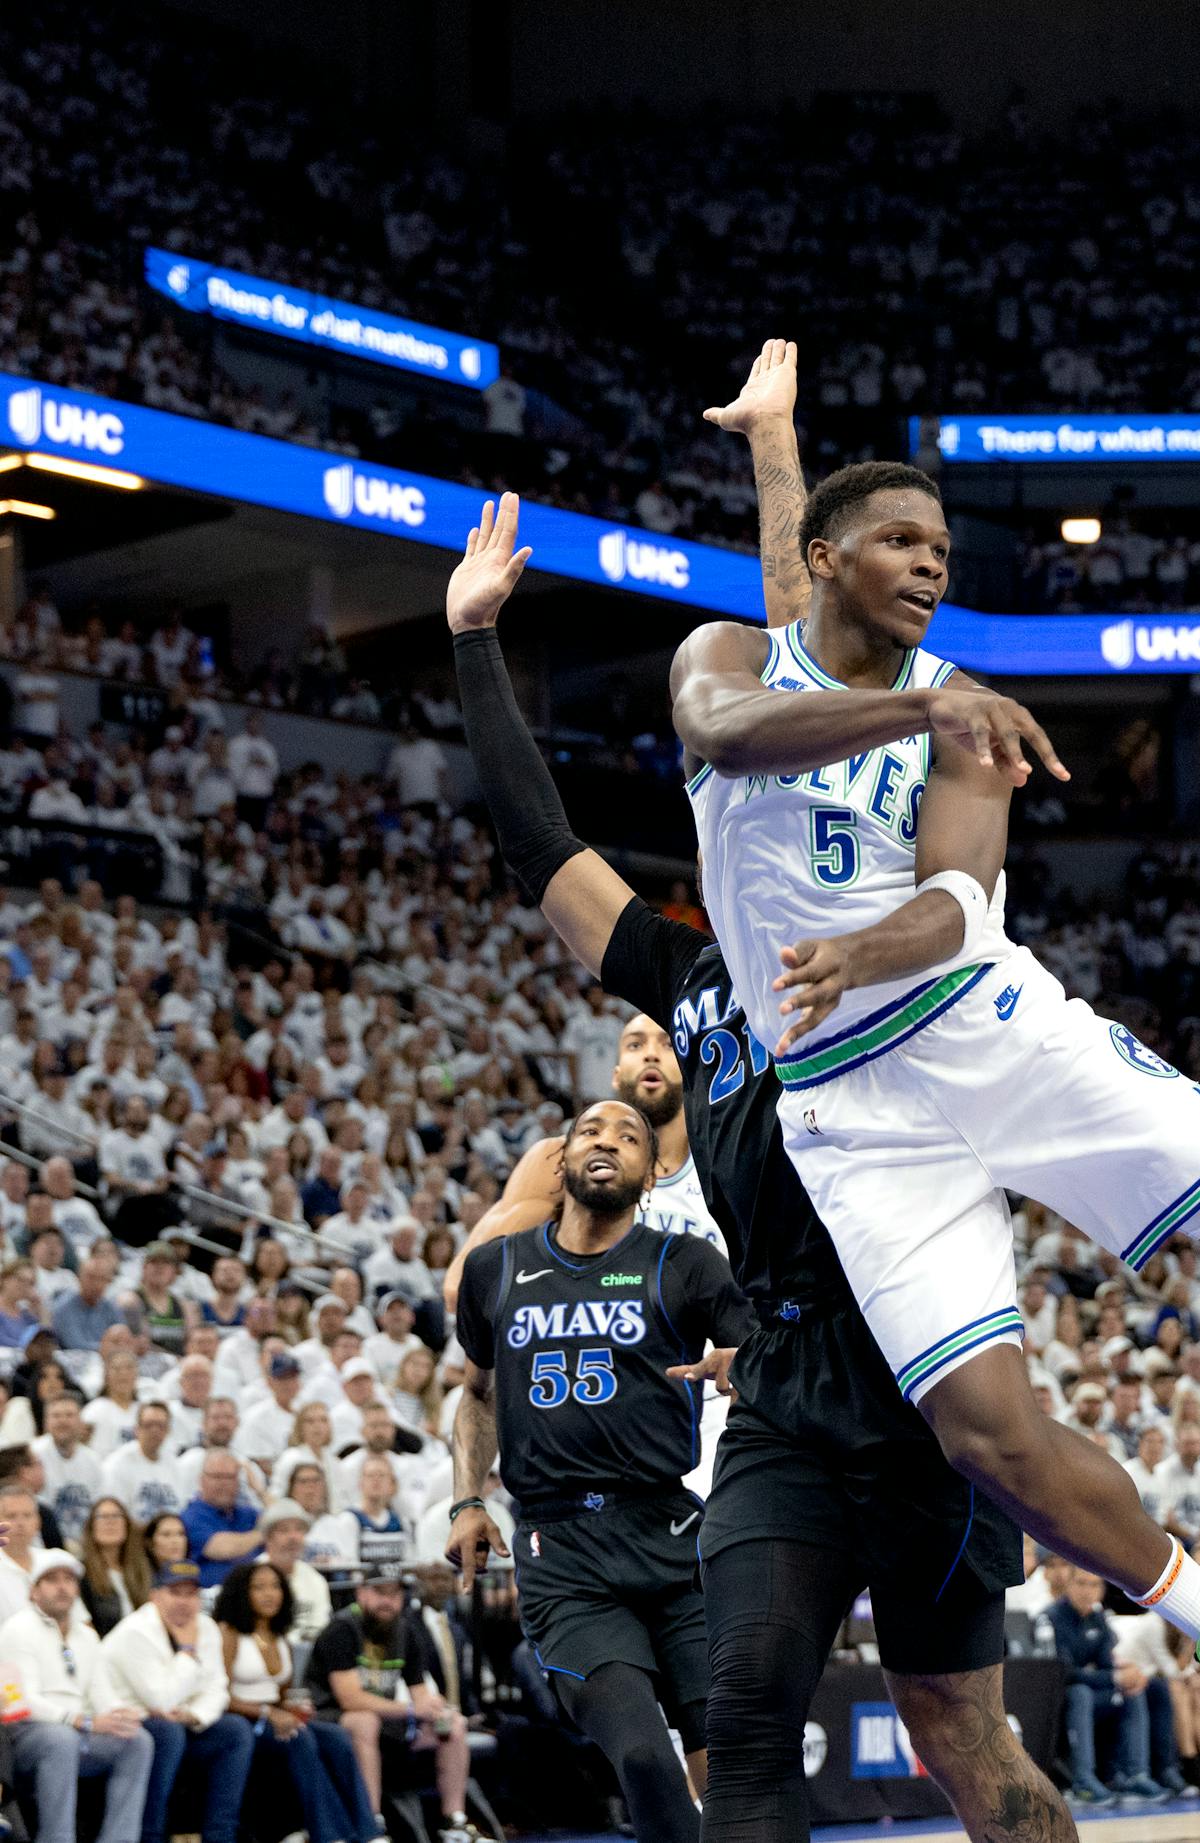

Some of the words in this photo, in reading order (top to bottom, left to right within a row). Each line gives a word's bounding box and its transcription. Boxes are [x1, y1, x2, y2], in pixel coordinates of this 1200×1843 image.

[361, 325, 449, 370] matters
[42, 399, 124, 455] UHC
[977, 425, 1056, 453] There
[1057, 424, 1097, 453] for
[1098, 425, 1165, 452] what
[354, 475, 426, 527] UHC
[626, 546, 690, 589] UHC
[808, 805, 861, 891] 5
[993, 984, 1014, 1011] NIKE
[600, 1272, 643, 1287] chime
[507, 1298, 647, 1349] MAVS
[528, 1347, 618, 1409] 55
